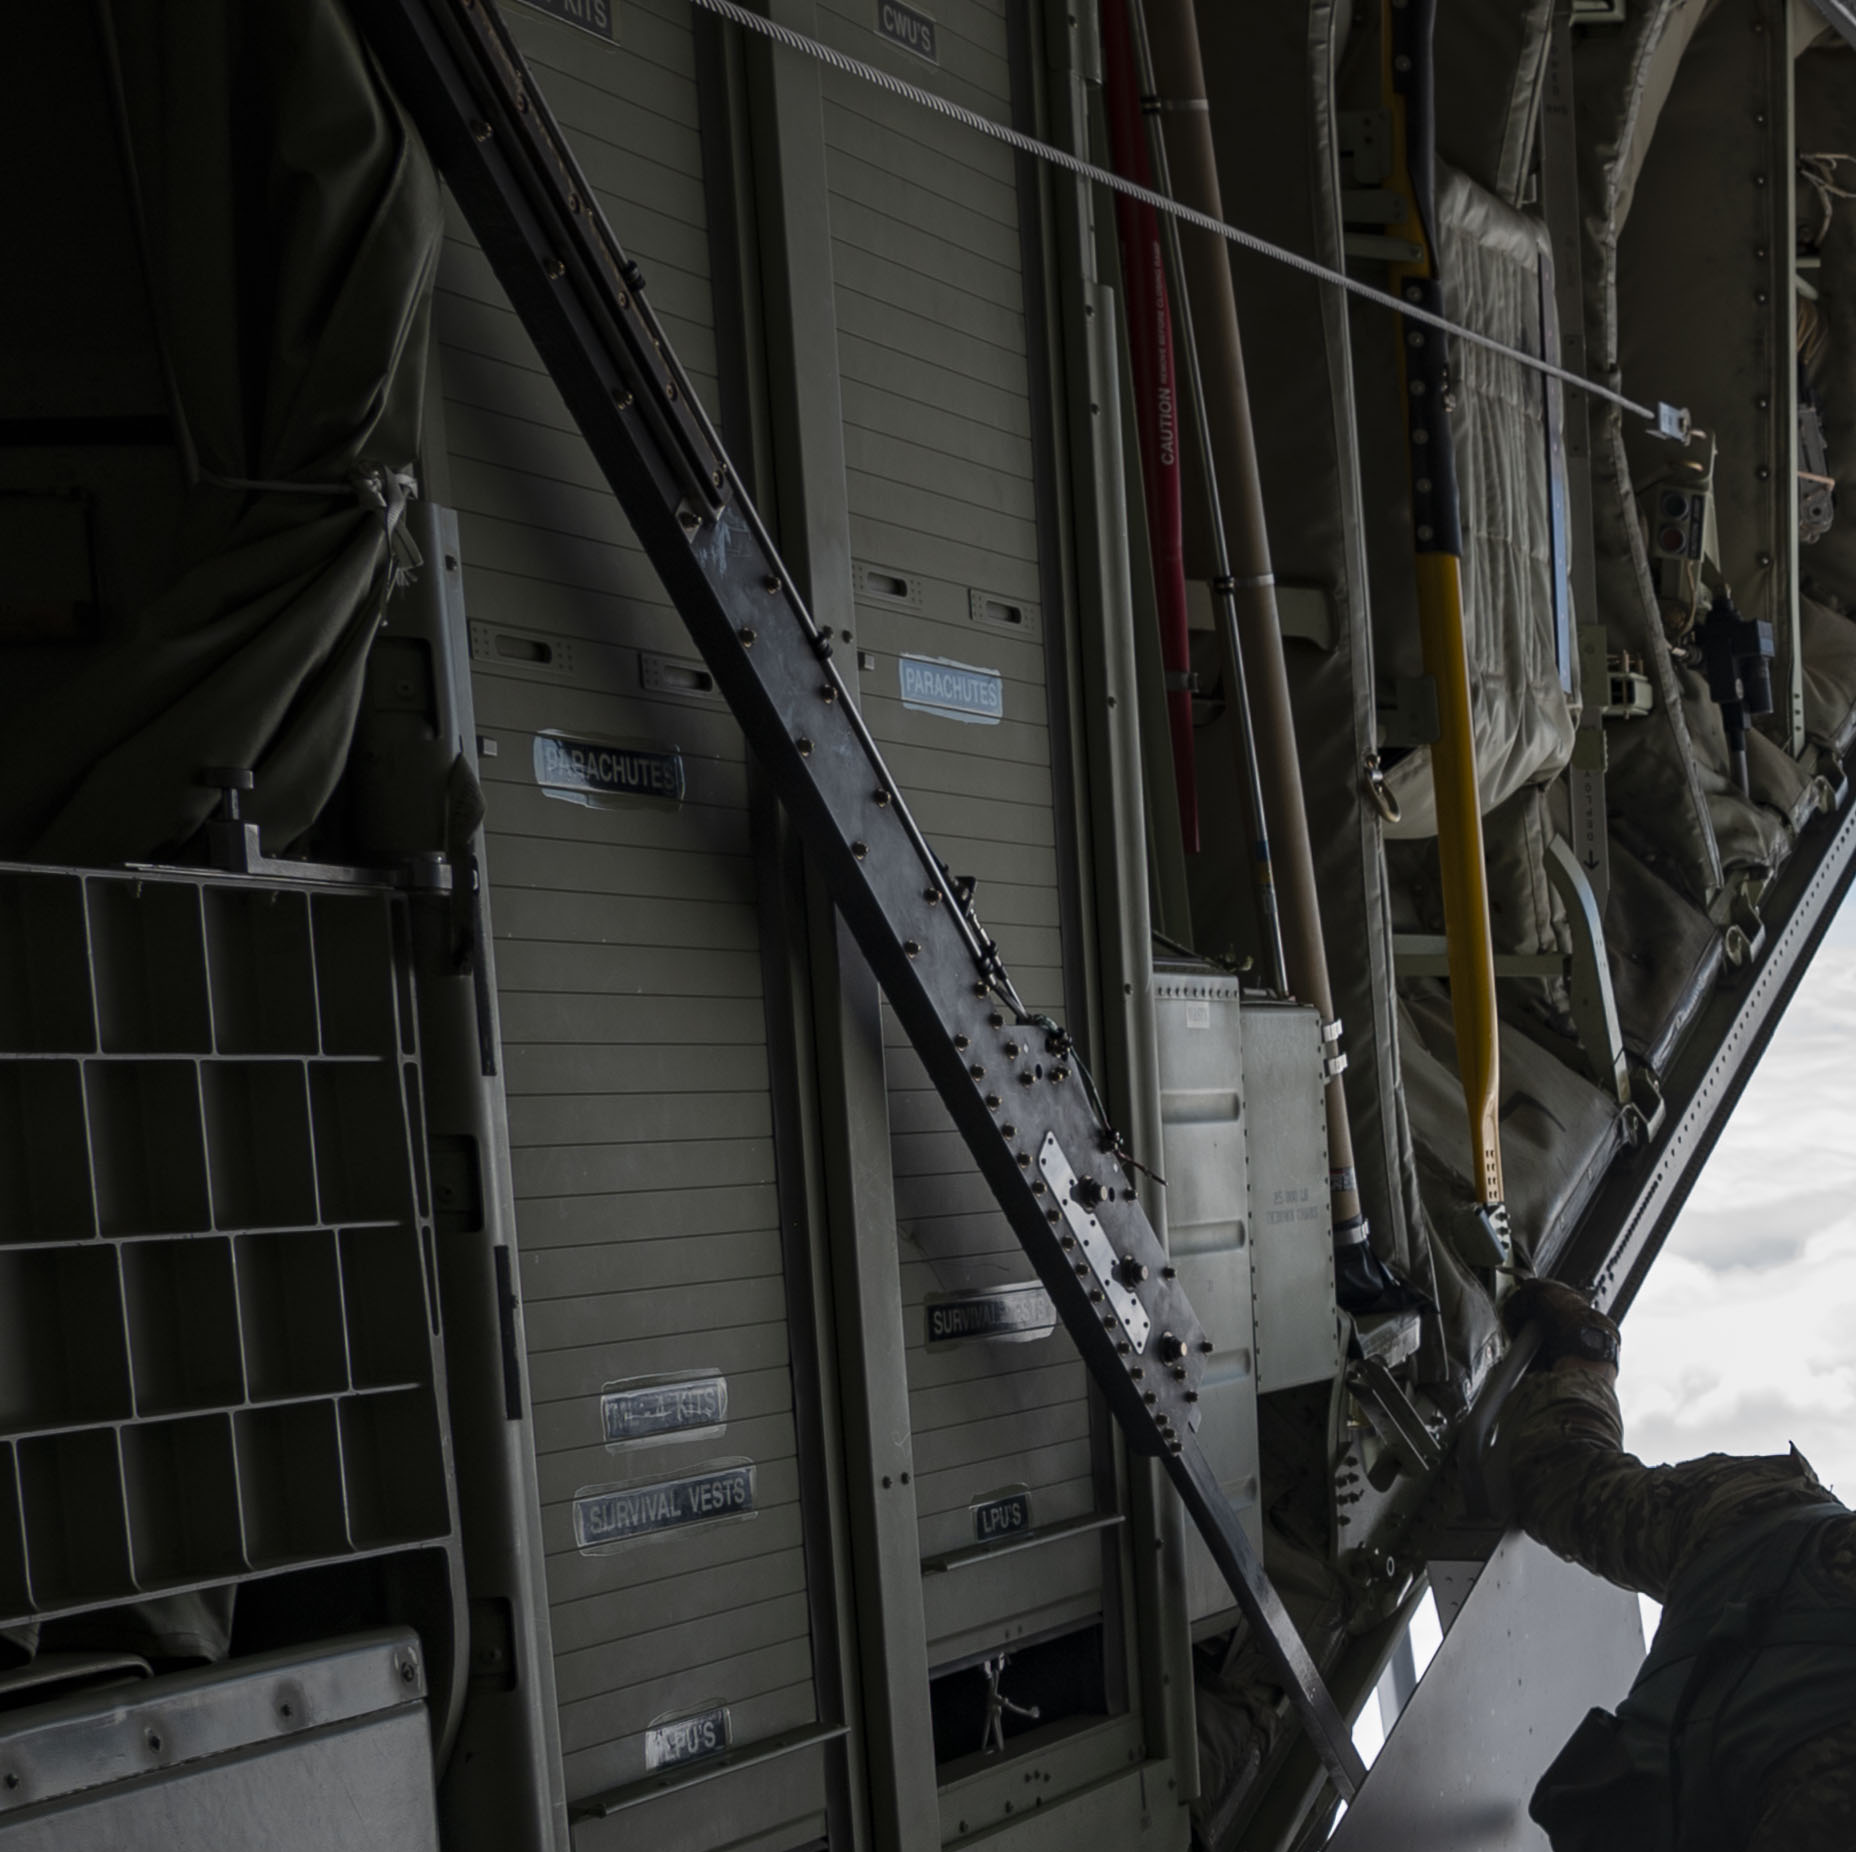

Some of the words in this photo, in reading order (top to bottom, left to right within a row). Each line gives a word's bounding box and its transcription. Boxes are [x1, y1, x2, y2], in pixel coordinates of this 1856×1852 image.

[883, 4, 932, 52] CWU'S
[1157, 387, 1175, 466] CAUTION
[905, 667, 997, 707] PARACHUTES
[544, 746, 674, 790] PARACHUTES
[933, 1303, 999, 1336] SURVIVAL
[589, 1489, 682, 1534] SURVIVAL
[688, 1477, 746, 1513] VESTS
[982, 1502, 1022, 1533] LPU'S
